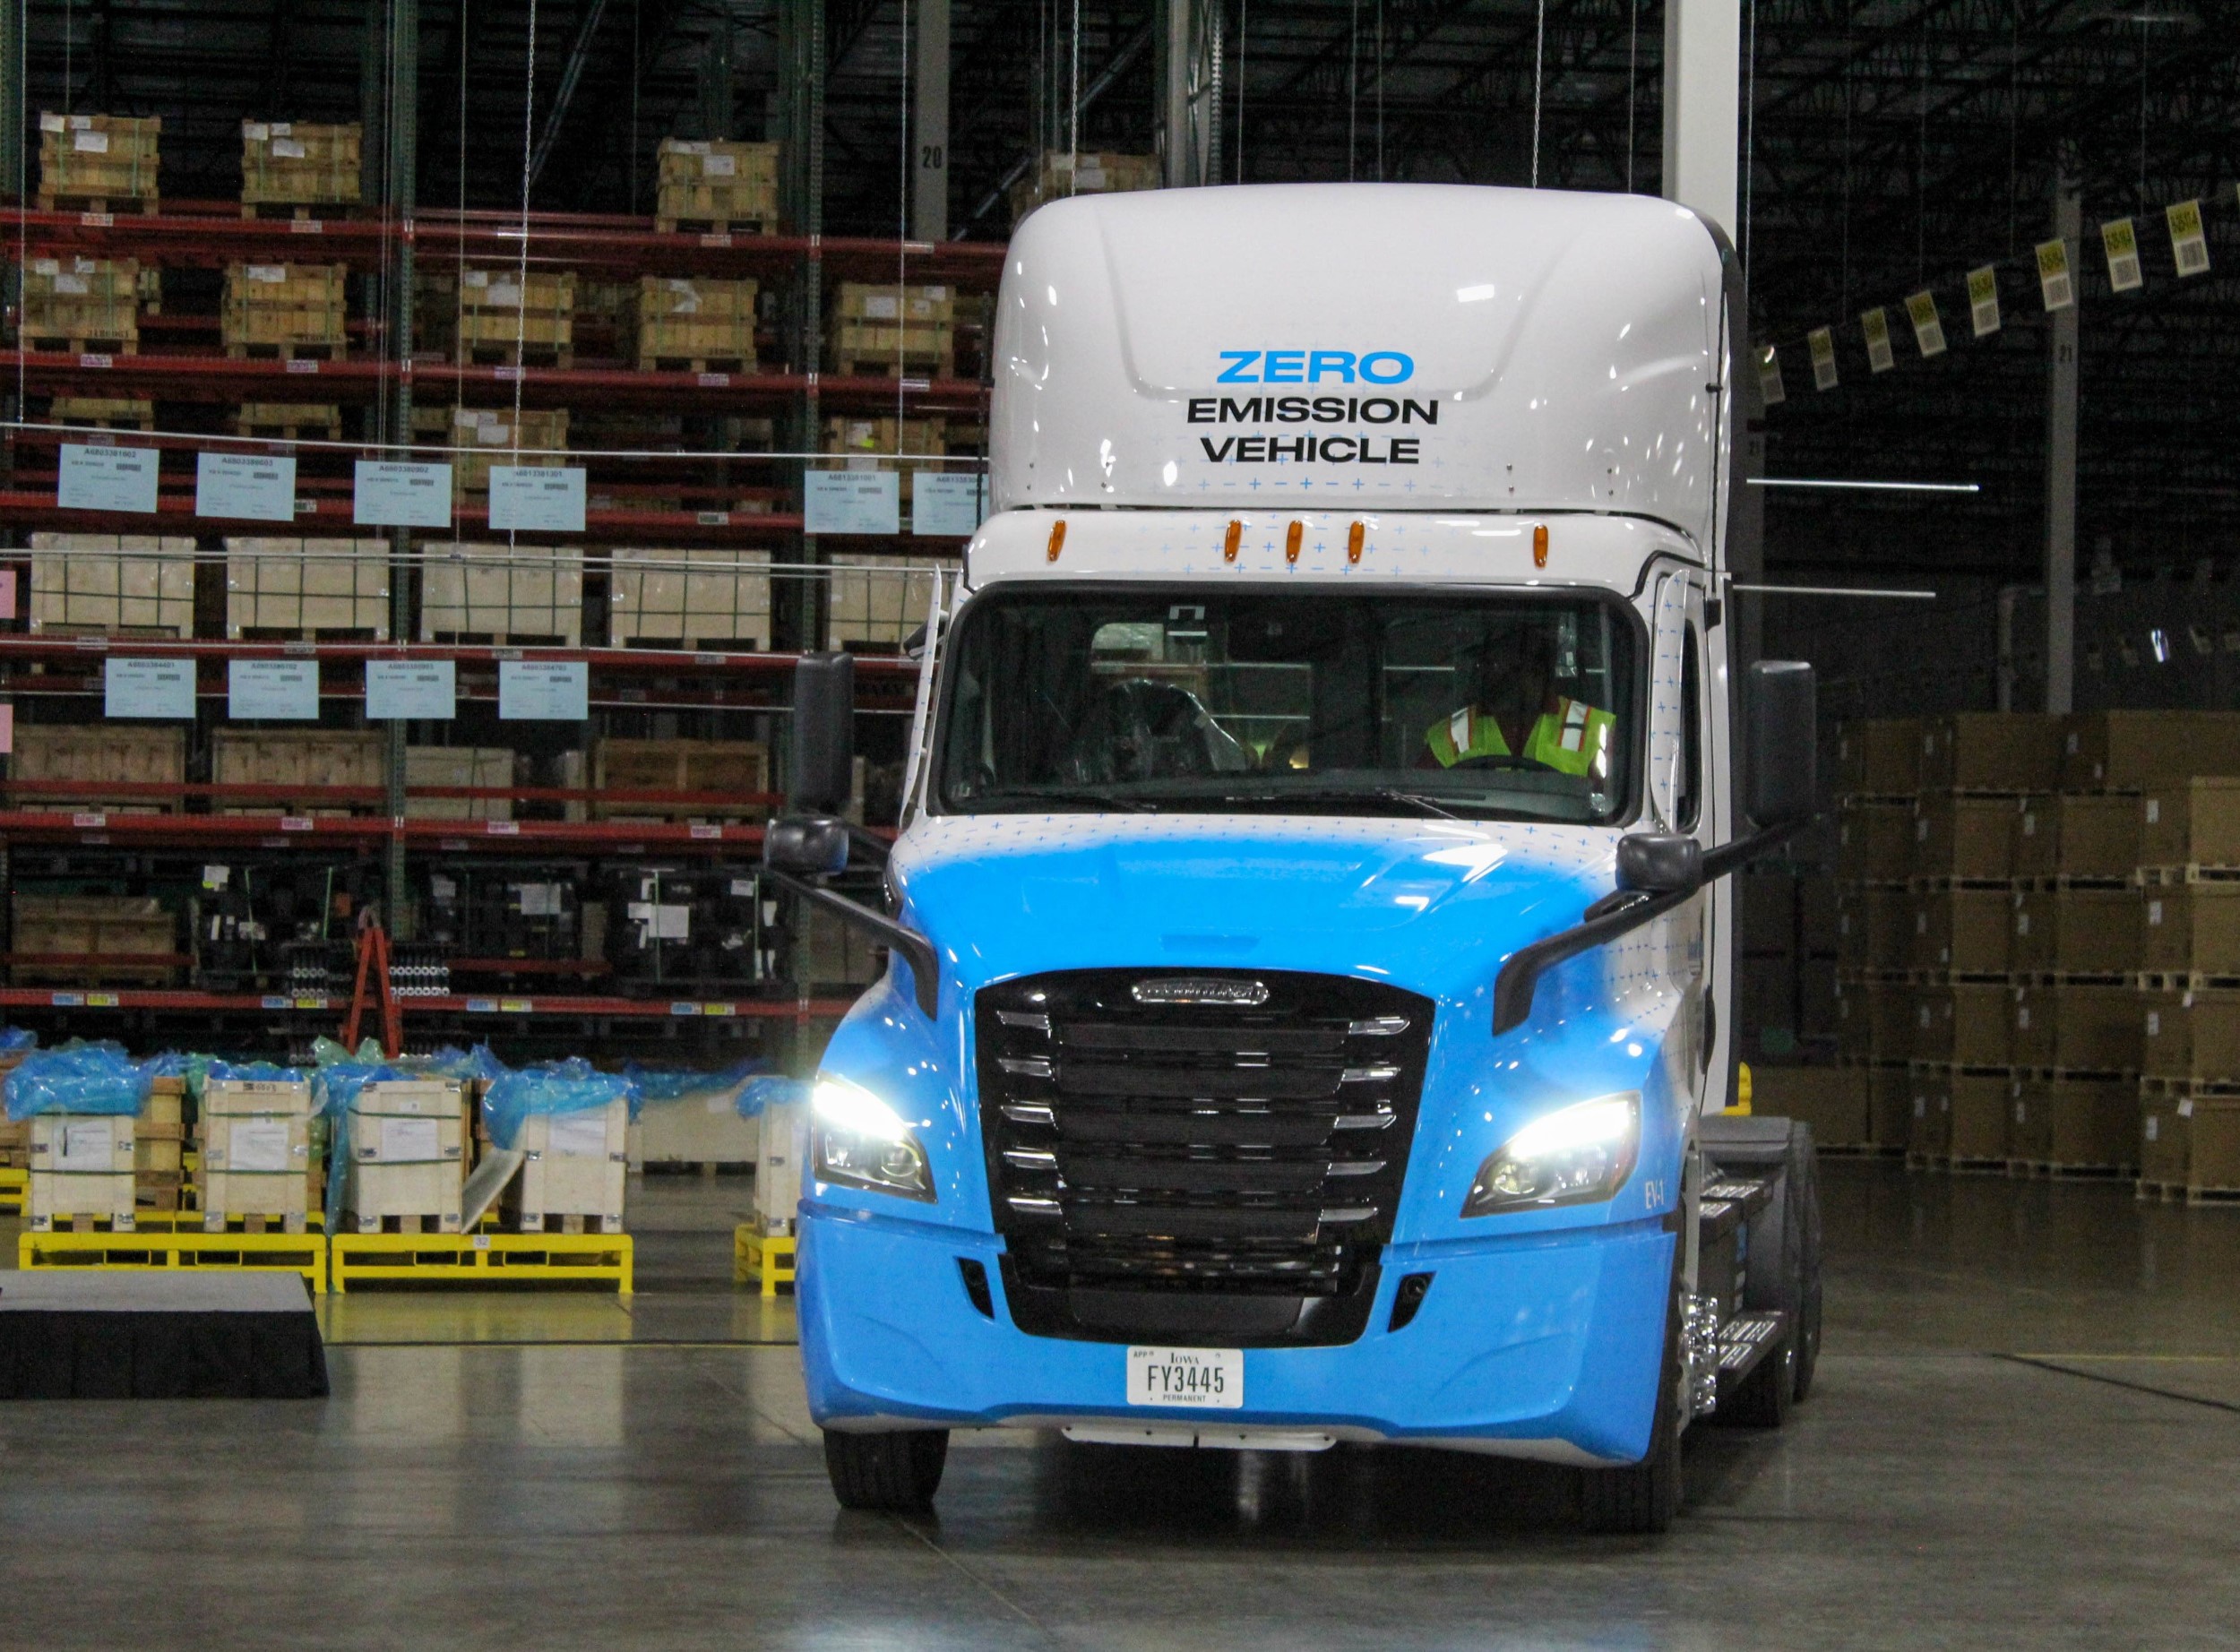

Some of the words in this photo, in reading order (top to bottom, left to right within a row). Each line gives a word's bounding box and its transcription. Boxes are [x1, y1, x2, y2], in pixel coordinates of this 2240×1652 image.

[922, 145, 942, 168] 20
[1217, 350, 1414, 384] ZERO
[1187, 397, 1438, 426] EMISSION
[1200, 437, 1419, 464] VEHICLE
[1645, 1179, 1664, 1209] EV-1
[1148, 1365, 1224, 1393] FY3445
[1163, 1394, 1207, 1403] PERMANENT
